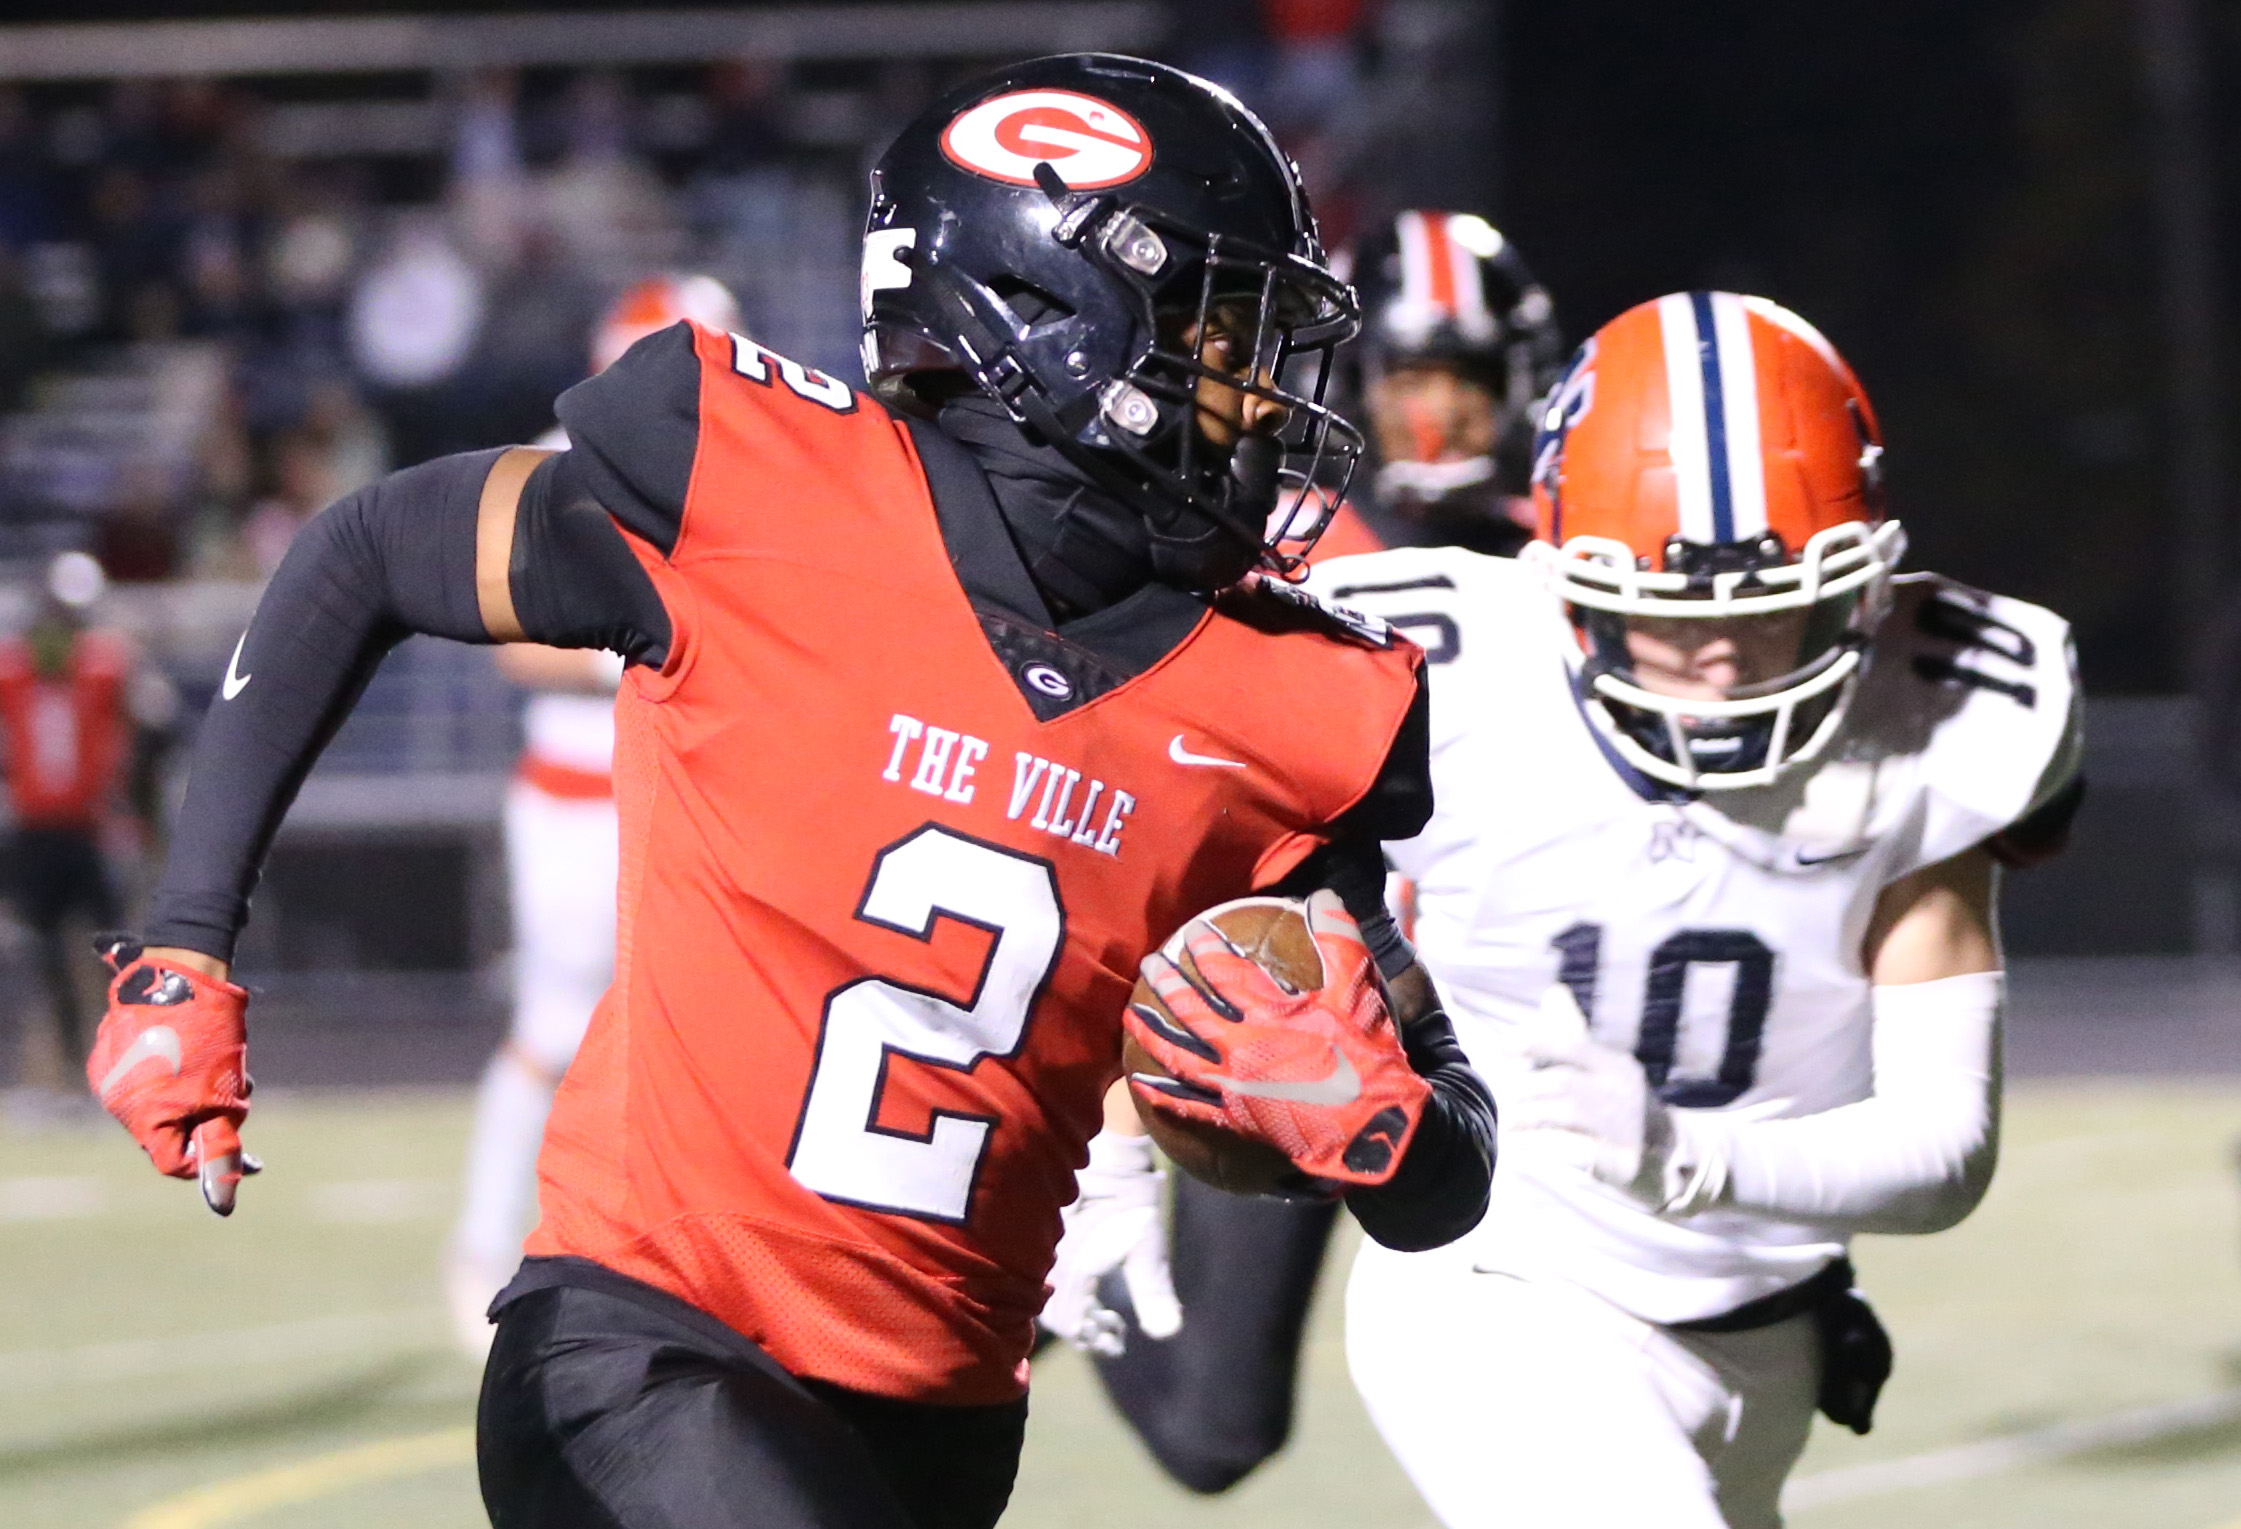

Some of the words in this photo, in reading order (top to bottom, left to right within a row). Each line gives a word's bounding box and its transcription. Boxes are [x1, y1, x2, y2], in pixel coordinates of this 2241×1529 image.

[944, 90, 1149, 186] G
[729, 331, 859, 415] 2
[1026, 666, 1071, 697] G
[882, 714, 990, 804] THE
[1007, 752, 1136, 857] VILLE
[787, 820, 1066, 1225] 2
